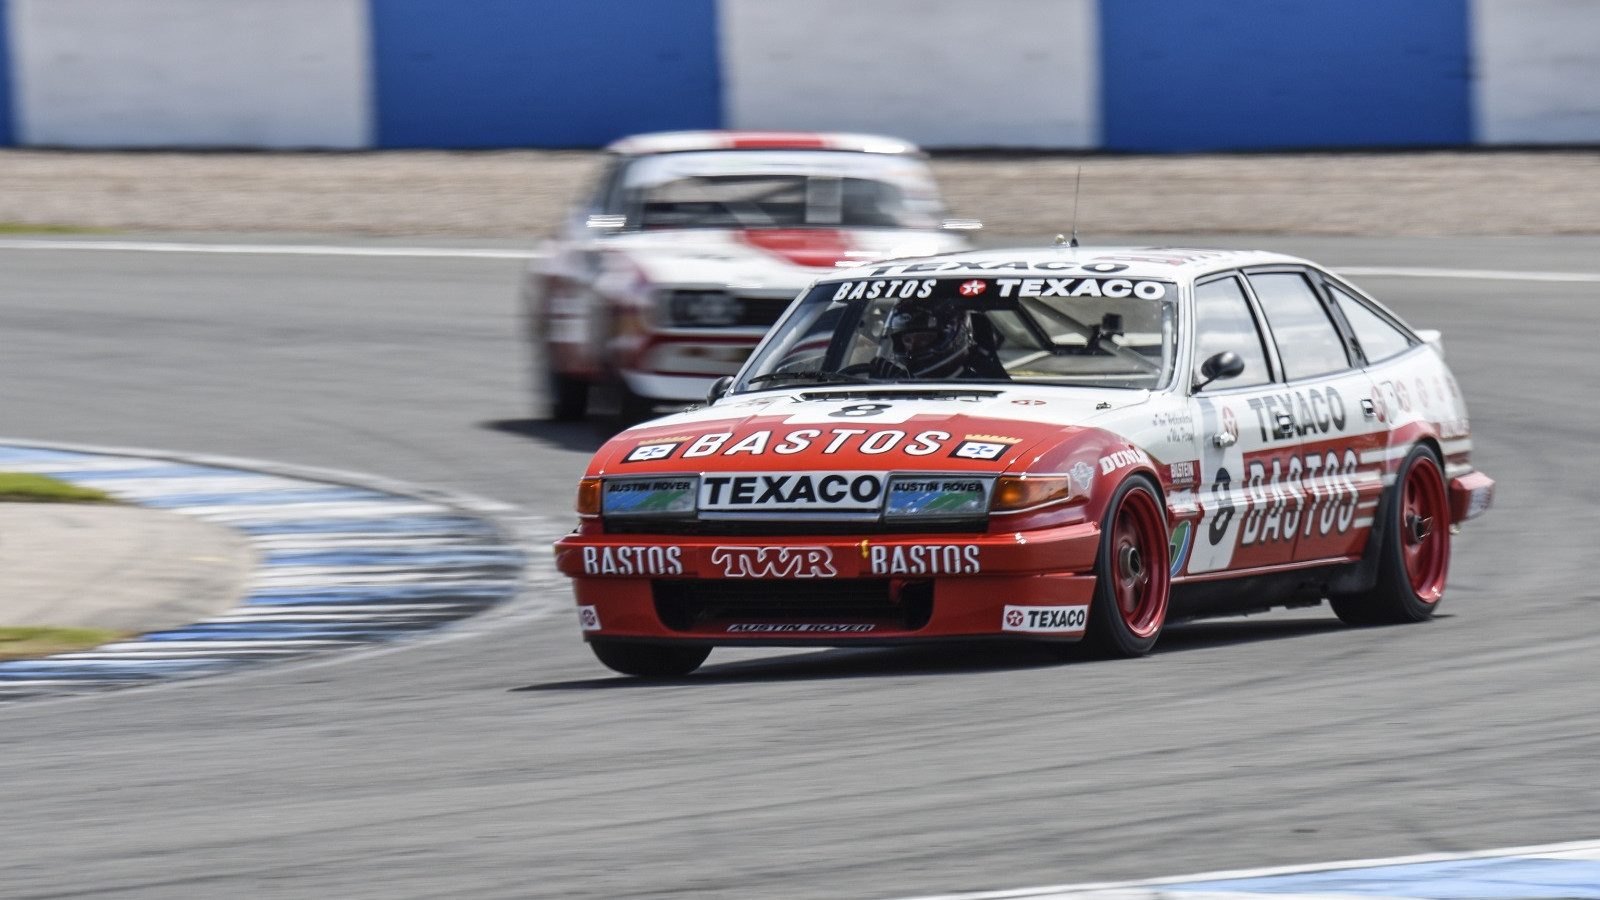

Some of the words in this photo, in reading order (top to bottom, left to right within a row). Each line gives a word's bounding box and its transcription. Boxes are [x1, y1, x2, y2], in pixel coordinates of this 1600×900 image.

[869, 261, 1129, 277] TEXACO
[833, 278, 937, 301] BASTOS
[995, 278, 1166, 300] TEXACO
[827, 403, 893, 418] 8
[1247, 385, 1346, 443] TEXACO
[681, 428, 952, 459] BASTOS
[609, 483, 649, 493] AUSTIN
[652, 481, 691, 492] ROVER
[703, 475, 881, 505] TEXACO
[893, 481, 938, 492] AUSTIN
[941, 480, 983, 492] ROVER
[1208, 467, 1235, 546] 8
[583, 546, 683, 575] BASTOS
[711, 546, 837, 578] TWR
[871, 545, 980, 575] BASTOS
[732, 624, 801, 632] AUSTIN
[807, 623, 874, 632] ROVER
[1028, 609, 1086, 628] TEXACO
